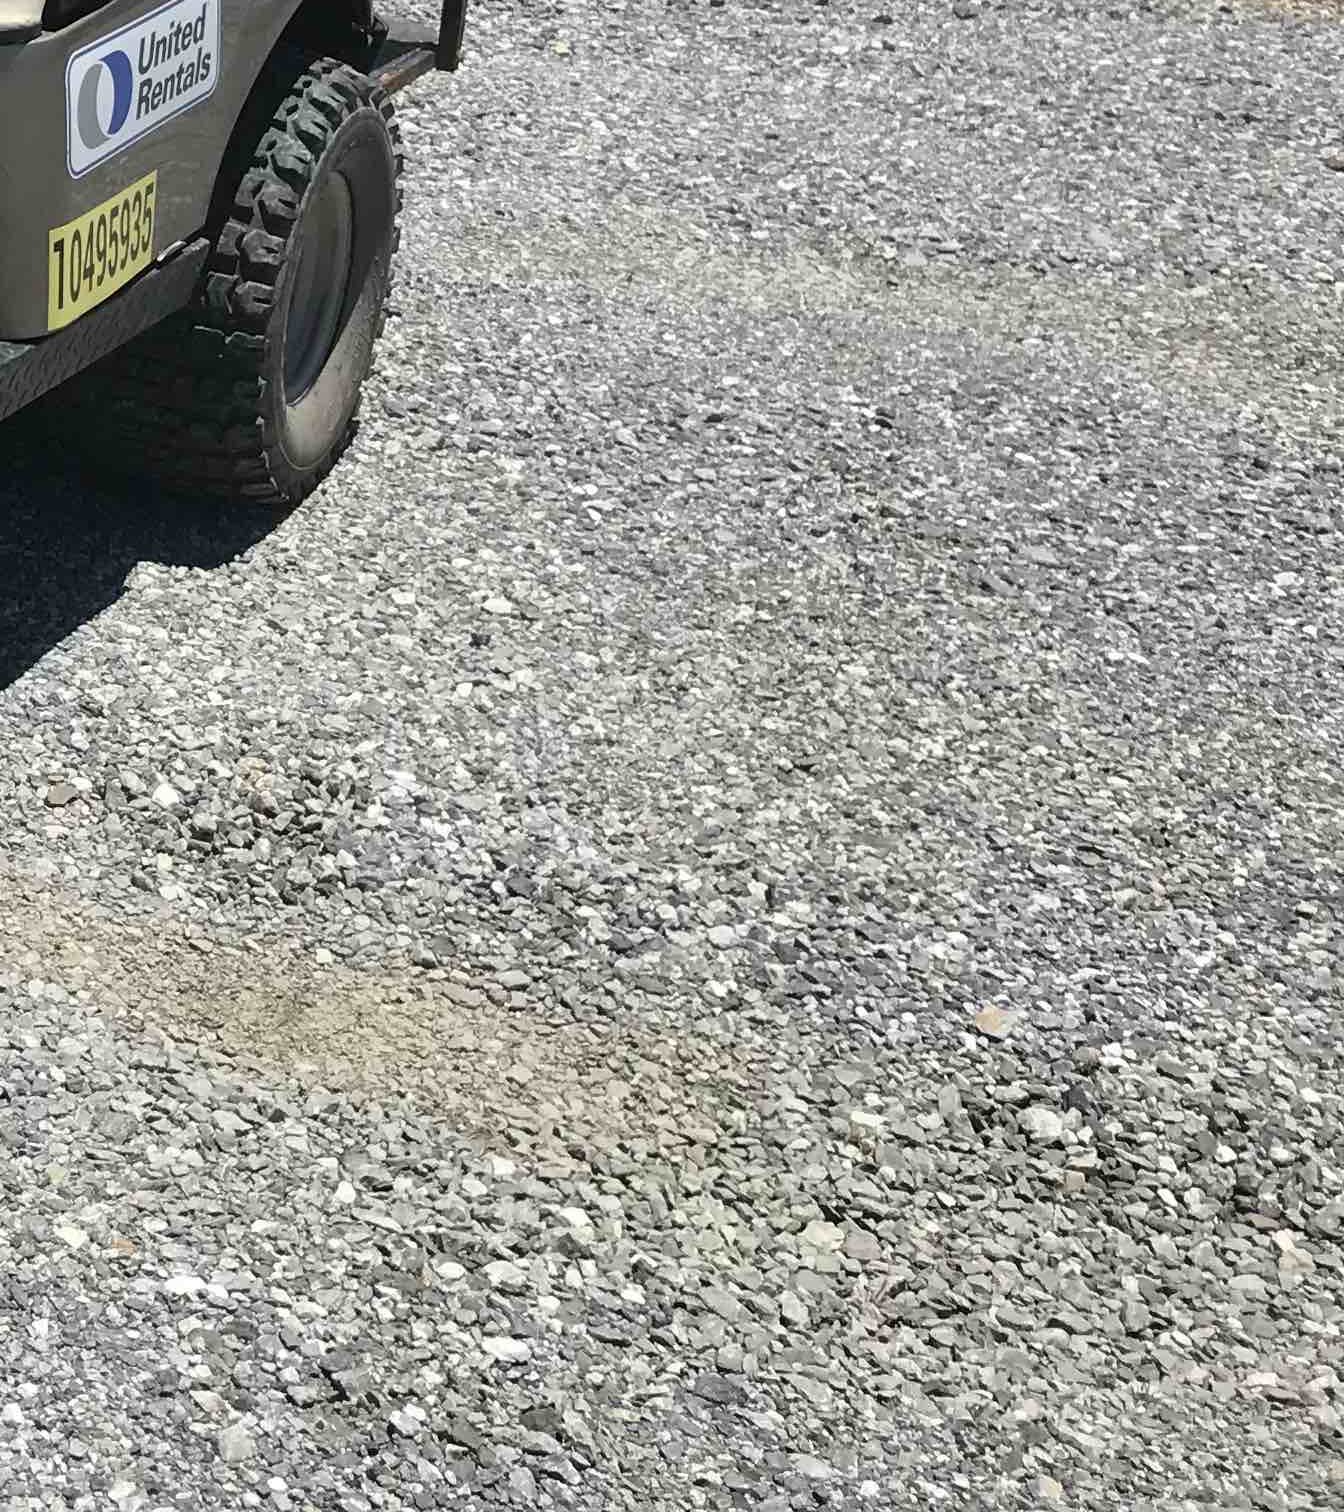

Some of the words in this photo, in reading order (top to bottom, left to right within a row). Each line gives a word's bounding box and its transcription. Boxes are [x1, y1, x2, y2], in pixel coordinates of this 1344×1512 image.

[137, 1, 208, 75] United
[135, 47, 211, 120] Rentals
[53, 182, 155, 311] 10495935
